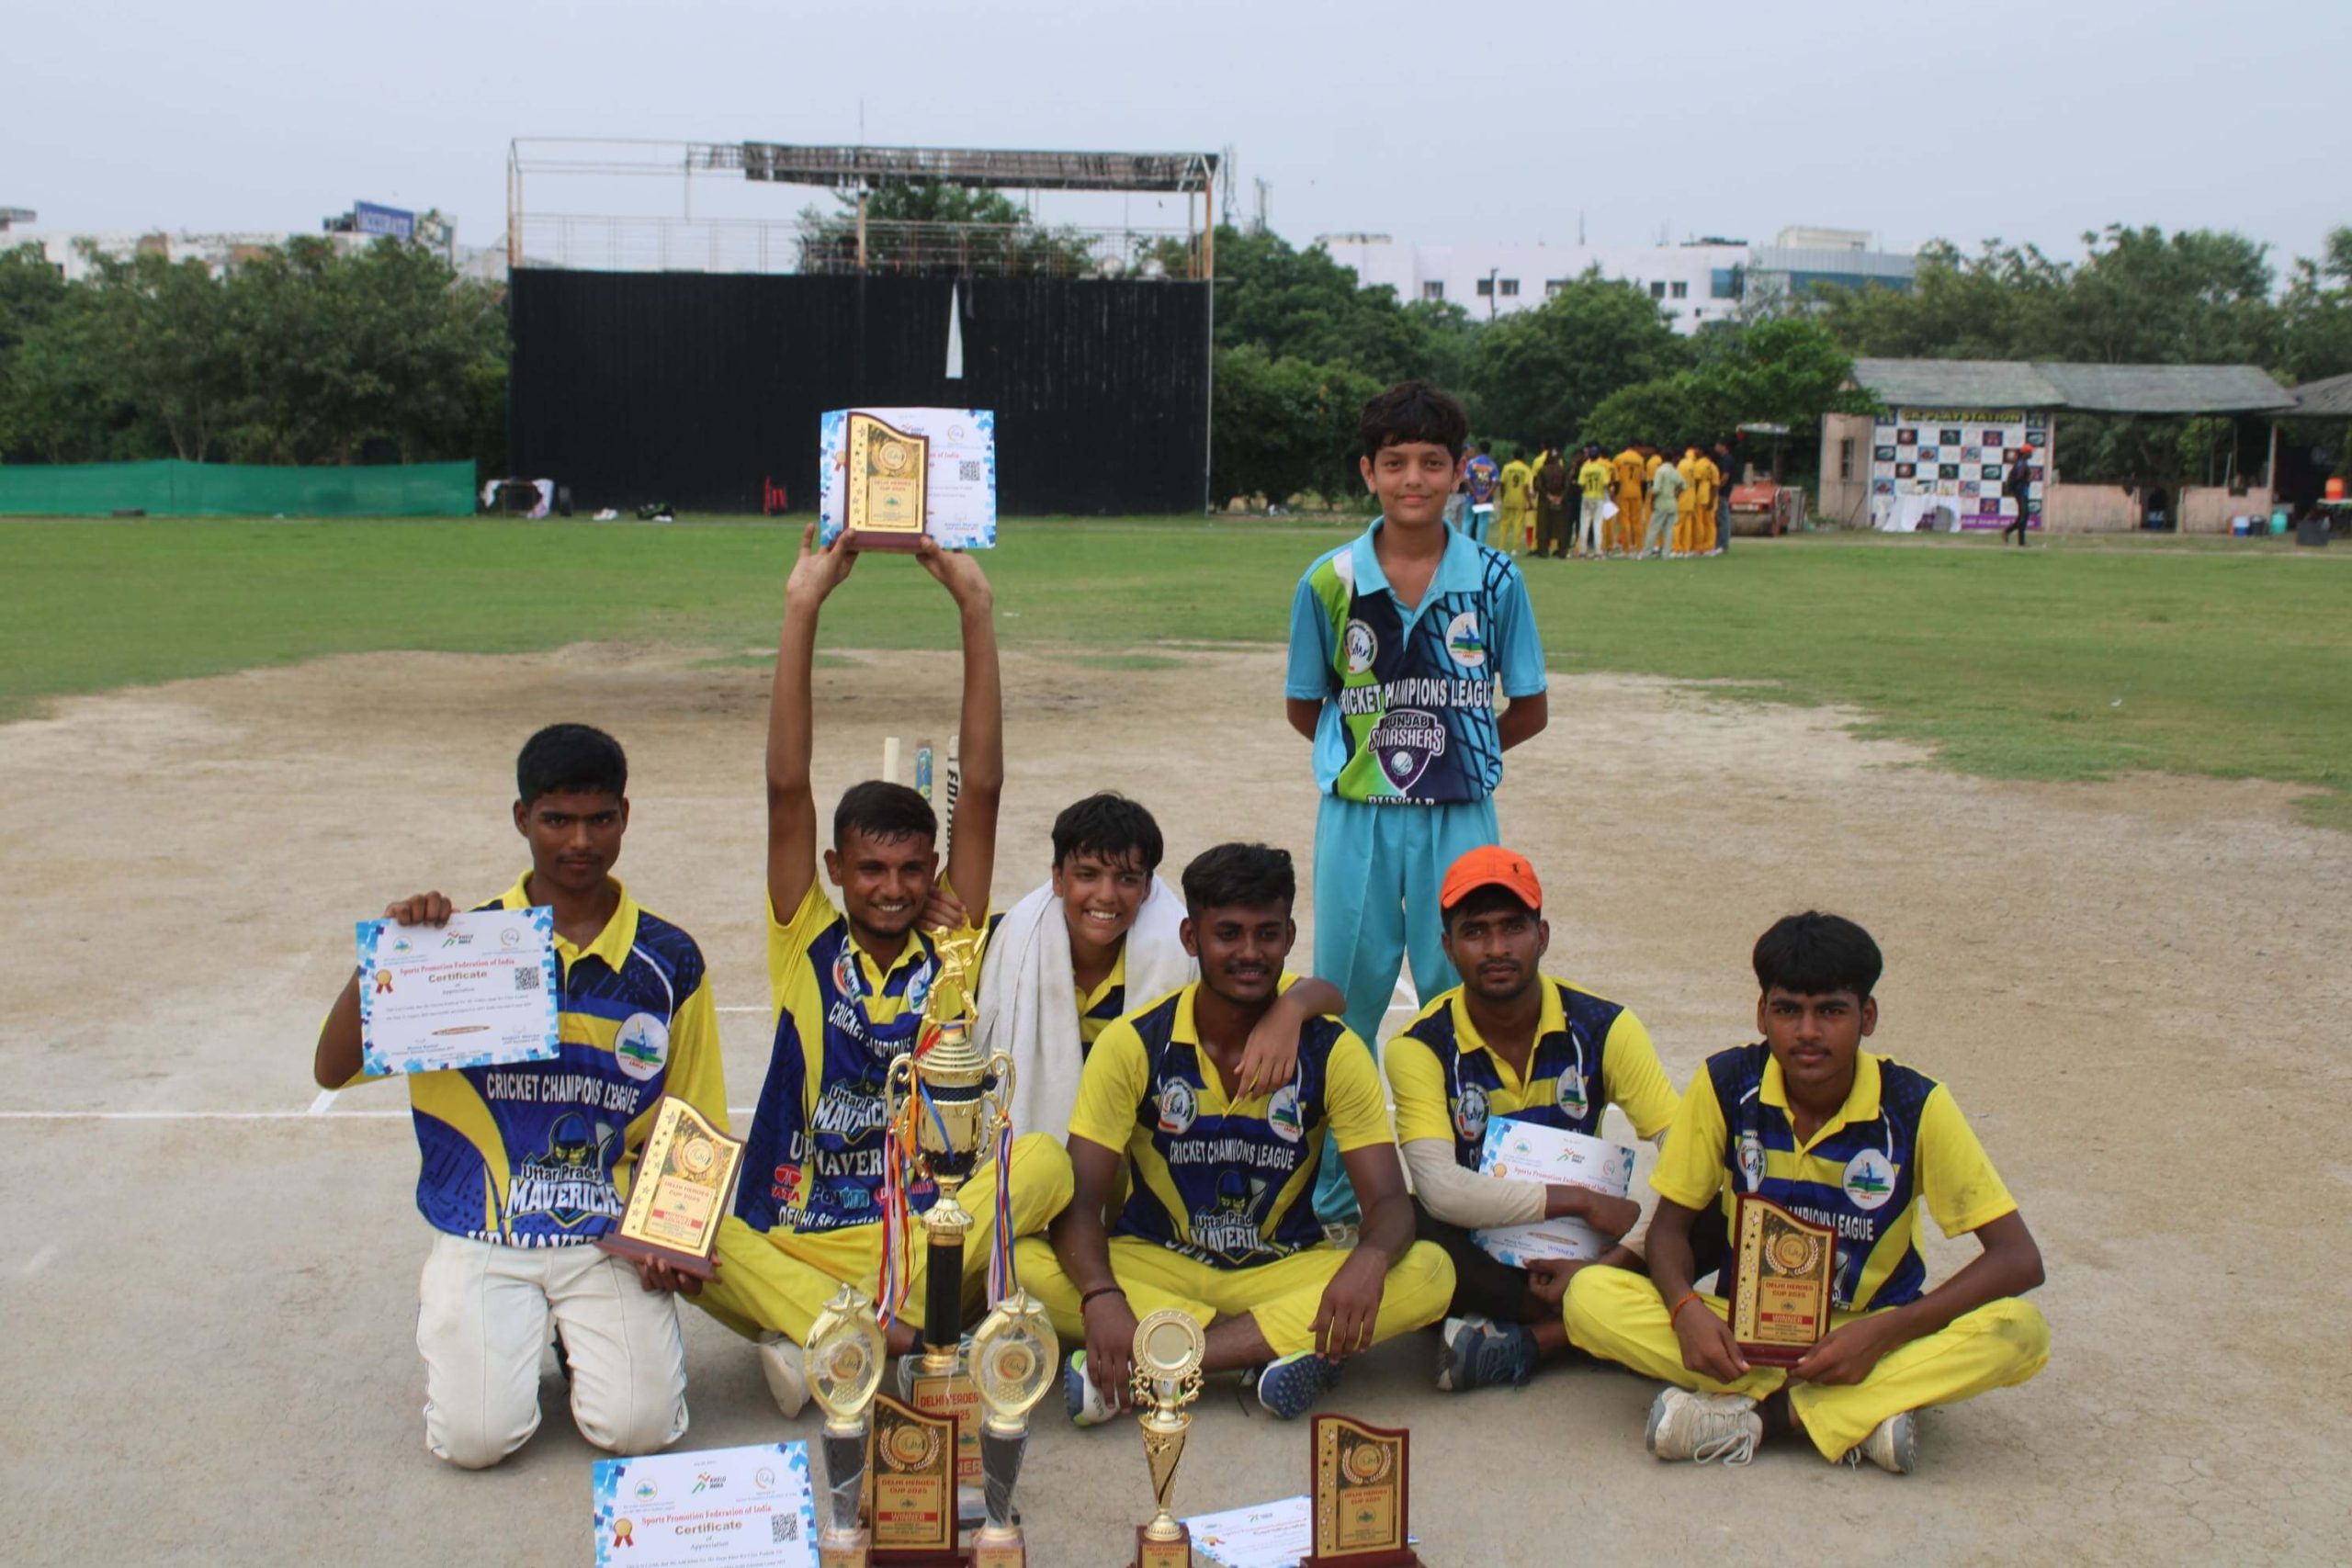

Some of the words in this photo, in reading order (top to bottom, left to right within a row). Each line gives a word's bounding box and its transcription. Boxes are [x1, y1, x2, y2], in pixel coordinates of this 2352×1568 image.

[1451, 679, 1490, 708] LEAGU
[1384, 714, 1430, 729] PUNJAB
[1370, 728, 1443, 753] SMASHERS
[428, 970, 488, 983] Certificate
[486, 1073, 539, 1100] CRICKET
[1170, 1140, 1205, 1165] CRICKET
[1256, 1144, 1295, 1170] LEAGUE
[523, 1164, 560, 1182] Uttar
[1196, 1215, 1227, 1229] Uttar
[1772, 1314, 1803, 1324] WINNER
[920, 1394, 944, 1407] DELHI
[642, 1515, 665, 1526] Sports
[666, 1511, 703, 1523] Promotion
[706, 1507, 743, 1519] Federation
[753, 1505, 772, 1514] India
[675, 1521, 742, 1535] Certificate
